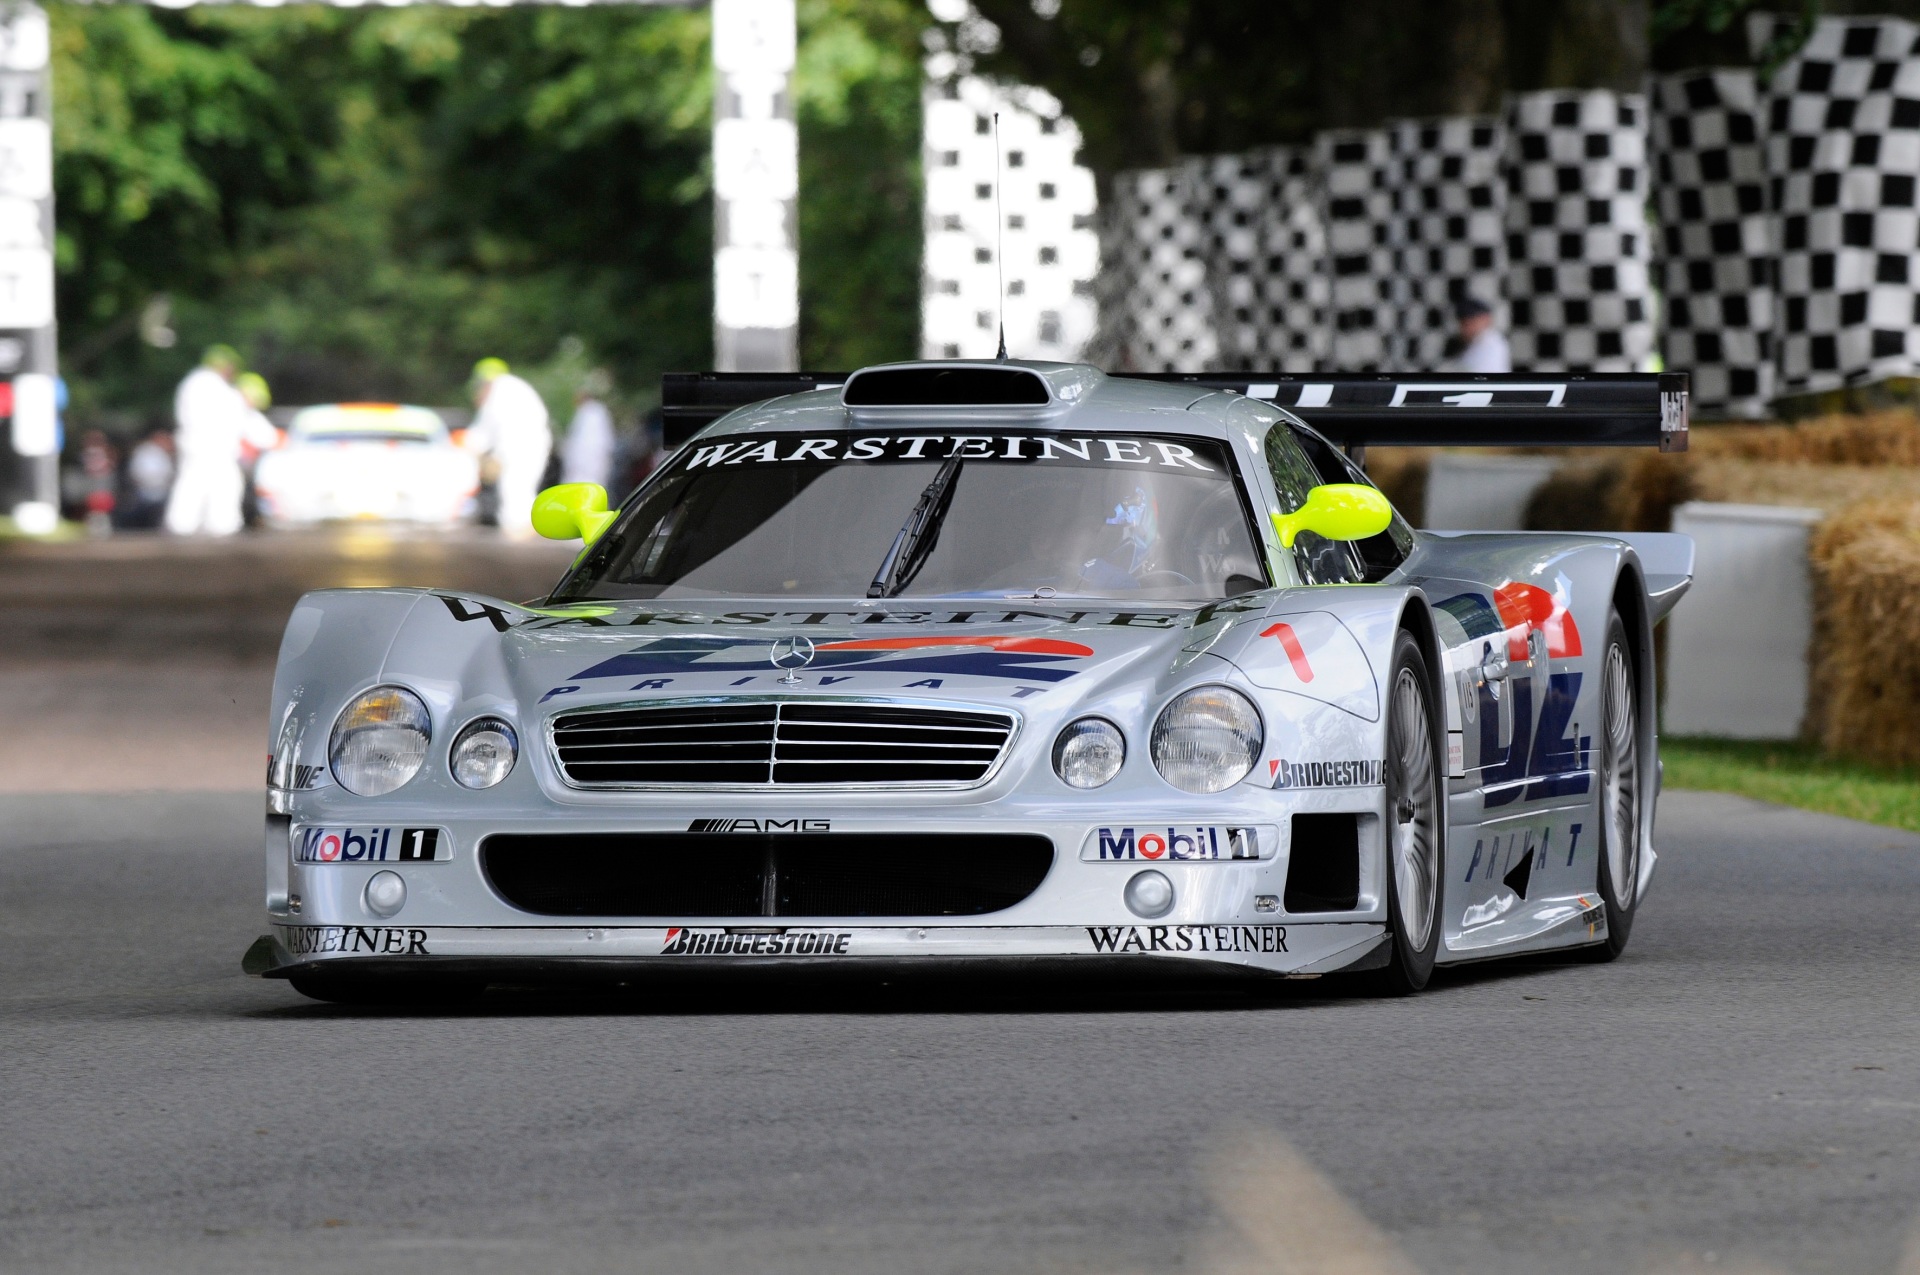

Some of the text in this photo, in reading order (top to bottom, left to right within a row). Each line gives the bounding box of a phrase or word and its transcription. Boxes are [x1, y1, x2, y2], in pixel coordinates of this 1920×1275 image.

[686, 436, 1215, 472] WARSTEINER
[1260, 622, 1314, 683] 1
[538, 676, 1047, 704] PRIVAT
[727, 819, 831, 832] AMG
[301, 828, 391, 861] Mobil
[1099, 828, 1218, 860] Mobil
[287, 927, 430, 954] WARSTEINER
[660, 928, 852, 954] BRIDGESTONE
[1085, 926, 1289, 952] WARSTEINER
